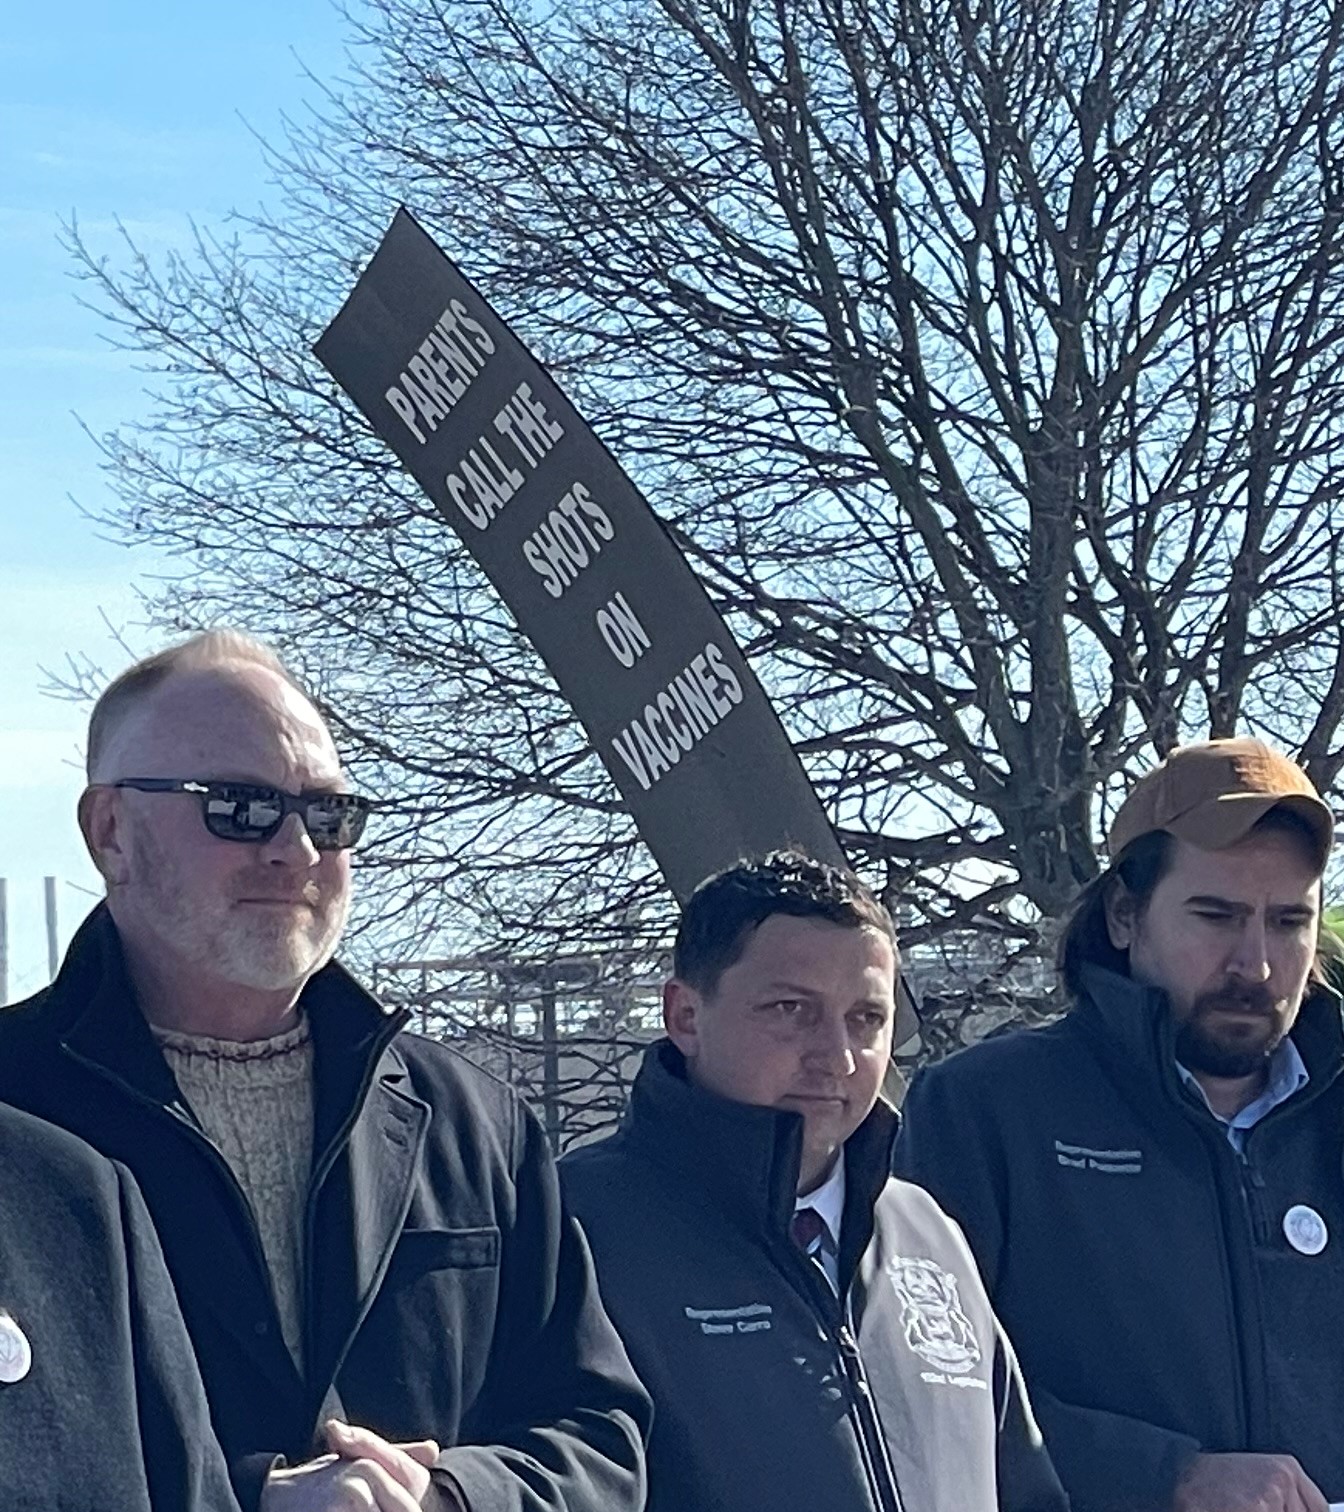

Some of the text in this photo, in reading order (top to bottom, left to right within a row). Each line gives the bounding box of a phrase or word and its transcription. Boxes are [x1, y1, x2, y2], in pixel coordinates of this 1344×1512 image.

[386, 298, 498, 444] PARENTS
[446, 382, 564, 531] CALL THE
[524, 482, 616, 600] SHOTS
[596, 592, 647, 669] ON
[612, 642, 744, 791] VACCINES
